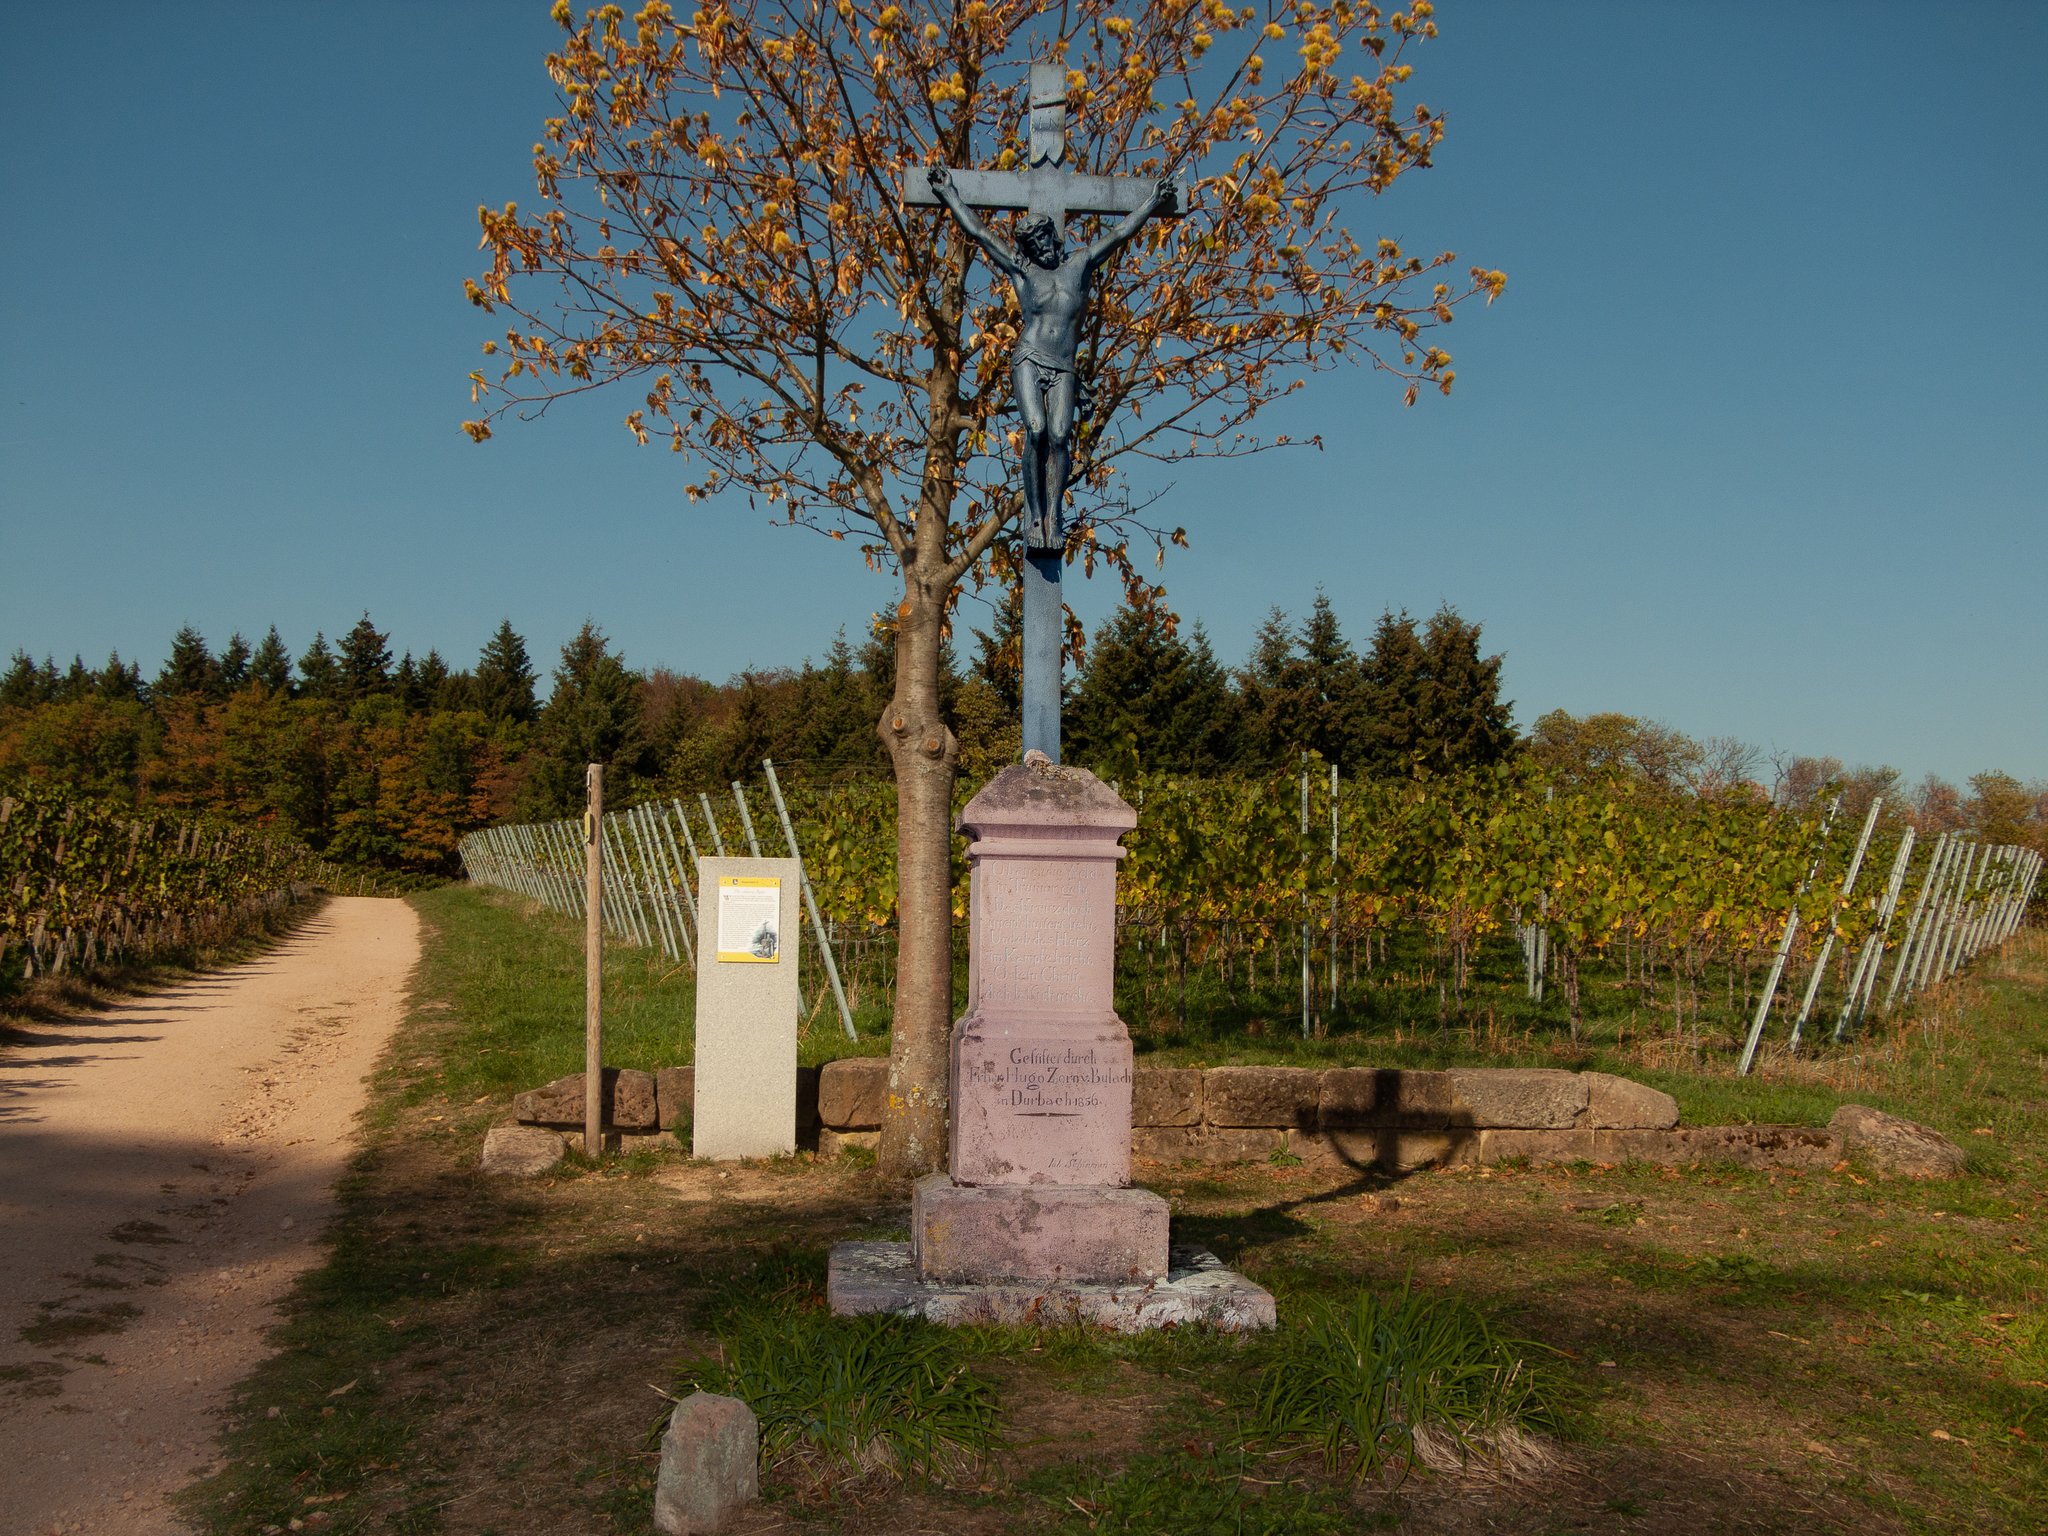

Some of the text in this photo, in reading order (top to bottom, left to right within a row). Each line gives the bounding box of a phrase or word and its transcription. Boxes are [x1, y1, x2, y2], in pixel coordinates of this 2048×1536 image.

[1063, 1047, 1097, 1065] durch
[1006, 1067, 1045, 1091] Hugo
[1047, 1067, 1080, 1084] Zorn
[1091, 1067, 1132, 1085] Bulach
